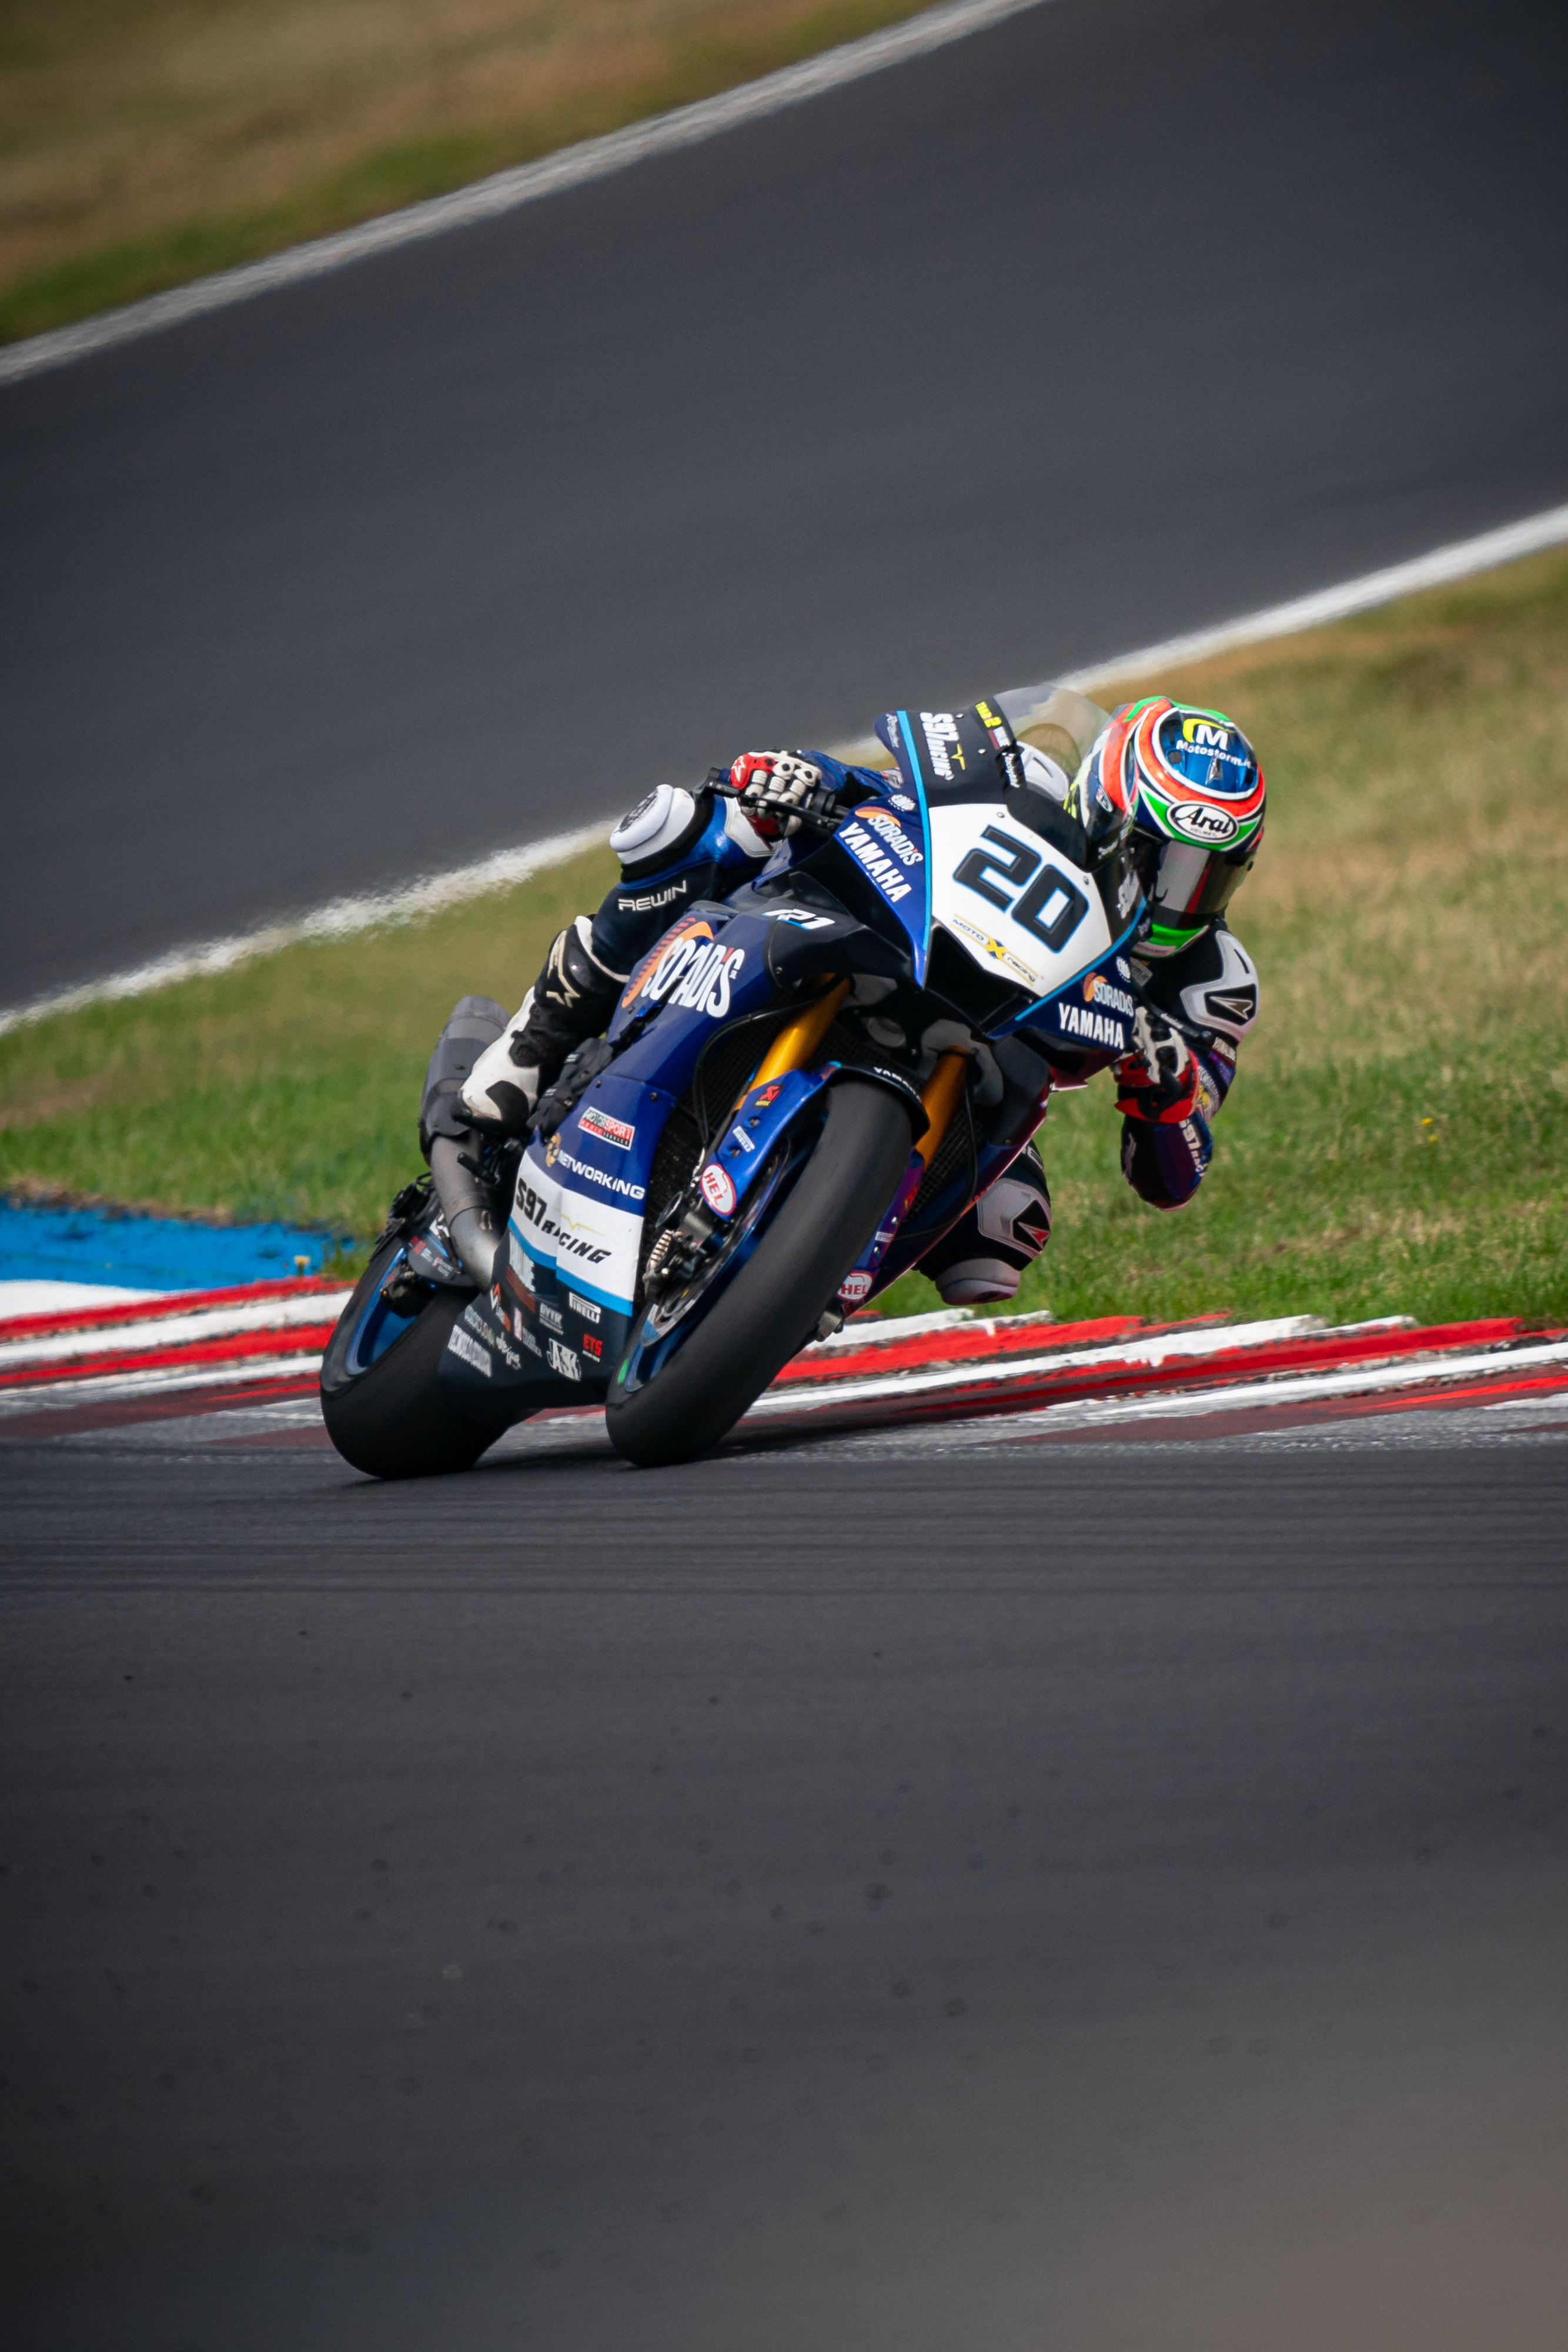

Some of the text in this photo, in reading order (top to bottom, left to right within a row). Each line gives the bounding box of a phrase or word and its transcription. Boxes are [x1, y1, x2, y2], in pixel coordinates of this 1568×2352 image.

[1175, 807, 1230, 834] Arai
[839, 822, 912, 903] YAMAHA
[618, 880, 687, 912] REWIN
[952, 824, 1089, 954] 20
[1059, 1002, 1125, 1050] YAMAHA
[704, 1171, 723, 1206] HEL
[841, 1283, 868, 1295] HEL
[569, 1292, 601, 1324] PIRELLI
[583, 1333, 603, 1357] ETS
